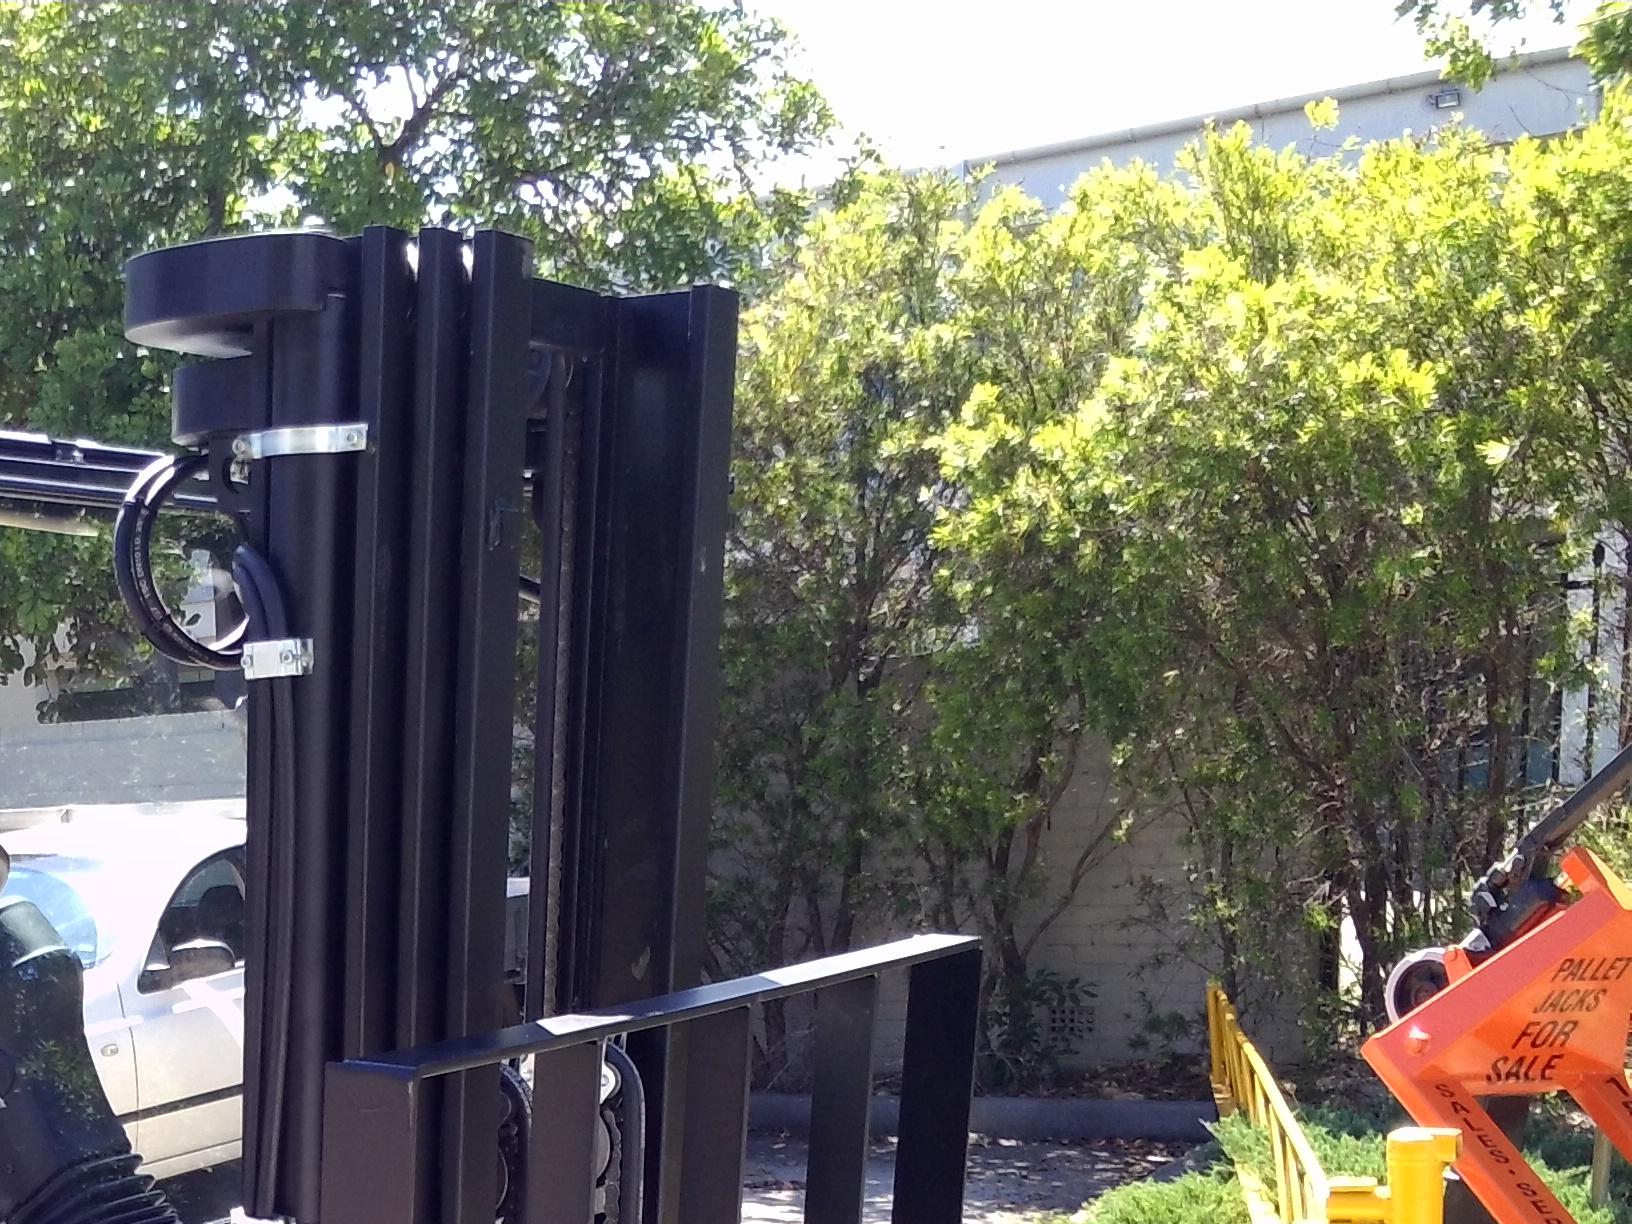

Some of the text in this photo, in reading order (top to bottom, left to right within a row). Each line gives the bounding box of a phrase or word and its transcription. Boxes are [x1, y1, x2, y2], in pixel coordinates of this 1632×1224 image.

[1551, 957, 1632, 982] PALLET
[1533, 989, 1607, 1014] JACKS
[1511, 1020, 1579, 1049] FOR
[1485, 1053, 1565, 1083] SALE
[1435, 1083, 1510, 1165] SALES
